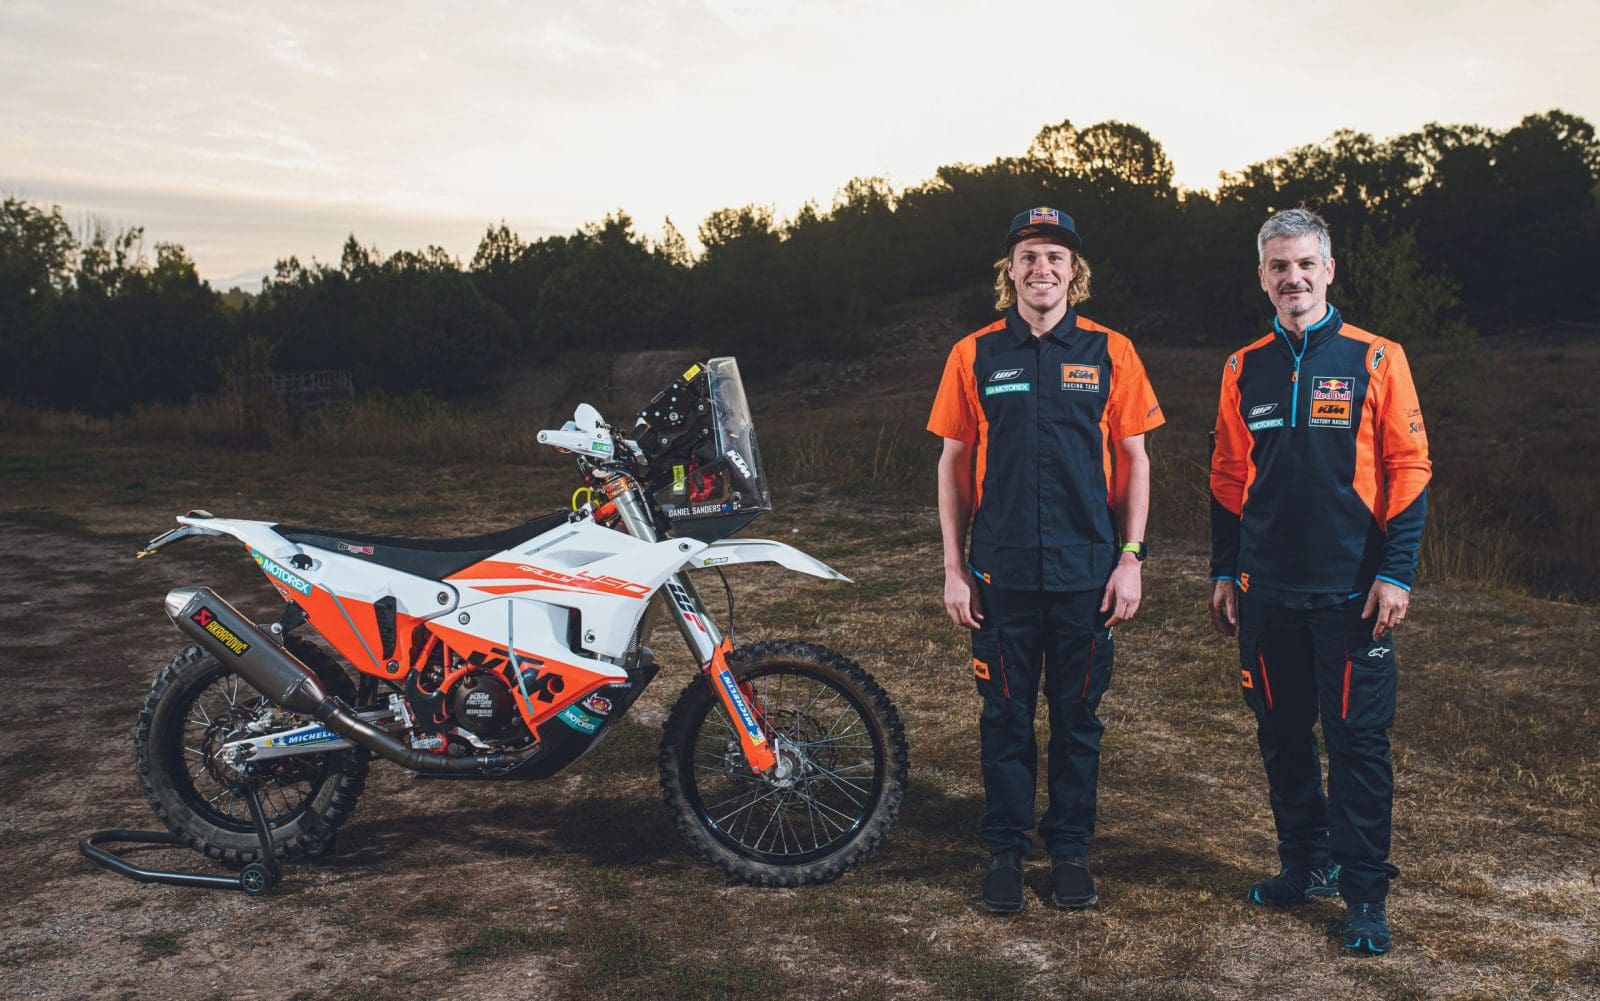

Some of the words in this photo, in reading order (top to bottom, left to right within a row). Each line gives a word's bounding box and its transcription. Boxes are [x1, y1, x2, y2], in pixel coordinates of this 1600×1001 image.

[1068, 369, 1094, 379] KTM
[995, 383, 1028, 394] MOTOREX
[1313, 390, 1332, 400] Red
[1333, 390, 1351, 401] Bull
[1317, 404, 1345, 414] KTM
[726, 449, 751, 479] KTM
[668, 507, 691, 518] DANIEL
[692, 504, 721, 515] SANDERS
[262, 559, 309, 594] MOTOREX
[723, 676, 755, 727] MICHELIN
[564, 710, 596, 730] MOTOREX
